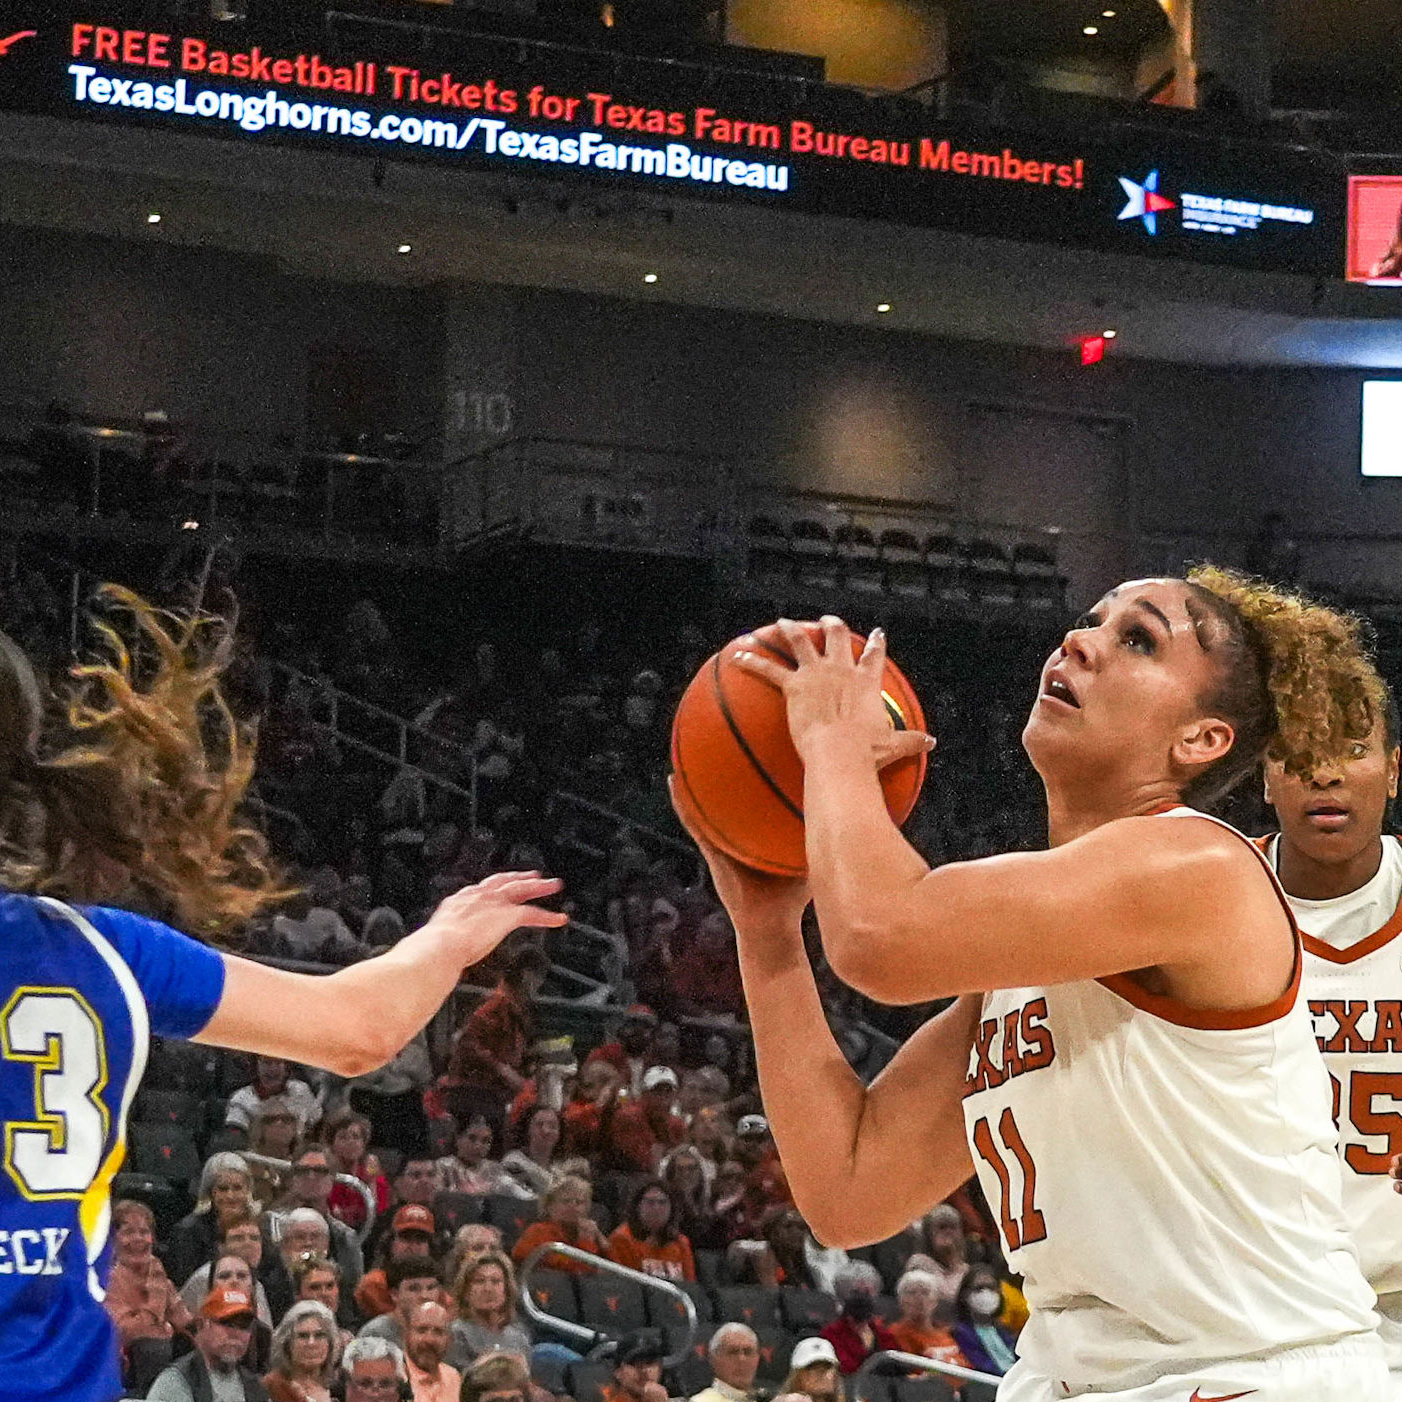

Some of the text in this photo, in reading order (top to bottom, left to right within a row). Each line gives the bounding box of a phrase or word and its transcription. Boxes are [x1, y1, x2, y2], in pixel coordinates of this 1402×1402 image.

[68, 64, 789, 191] TexasLonghorns.com/TexasFarmBureau
[72, 23, 1085, 189] FREE Basketball Tickets for Texas Farm Bureau Members!
[972, 1106, 1048, 1252] 11
